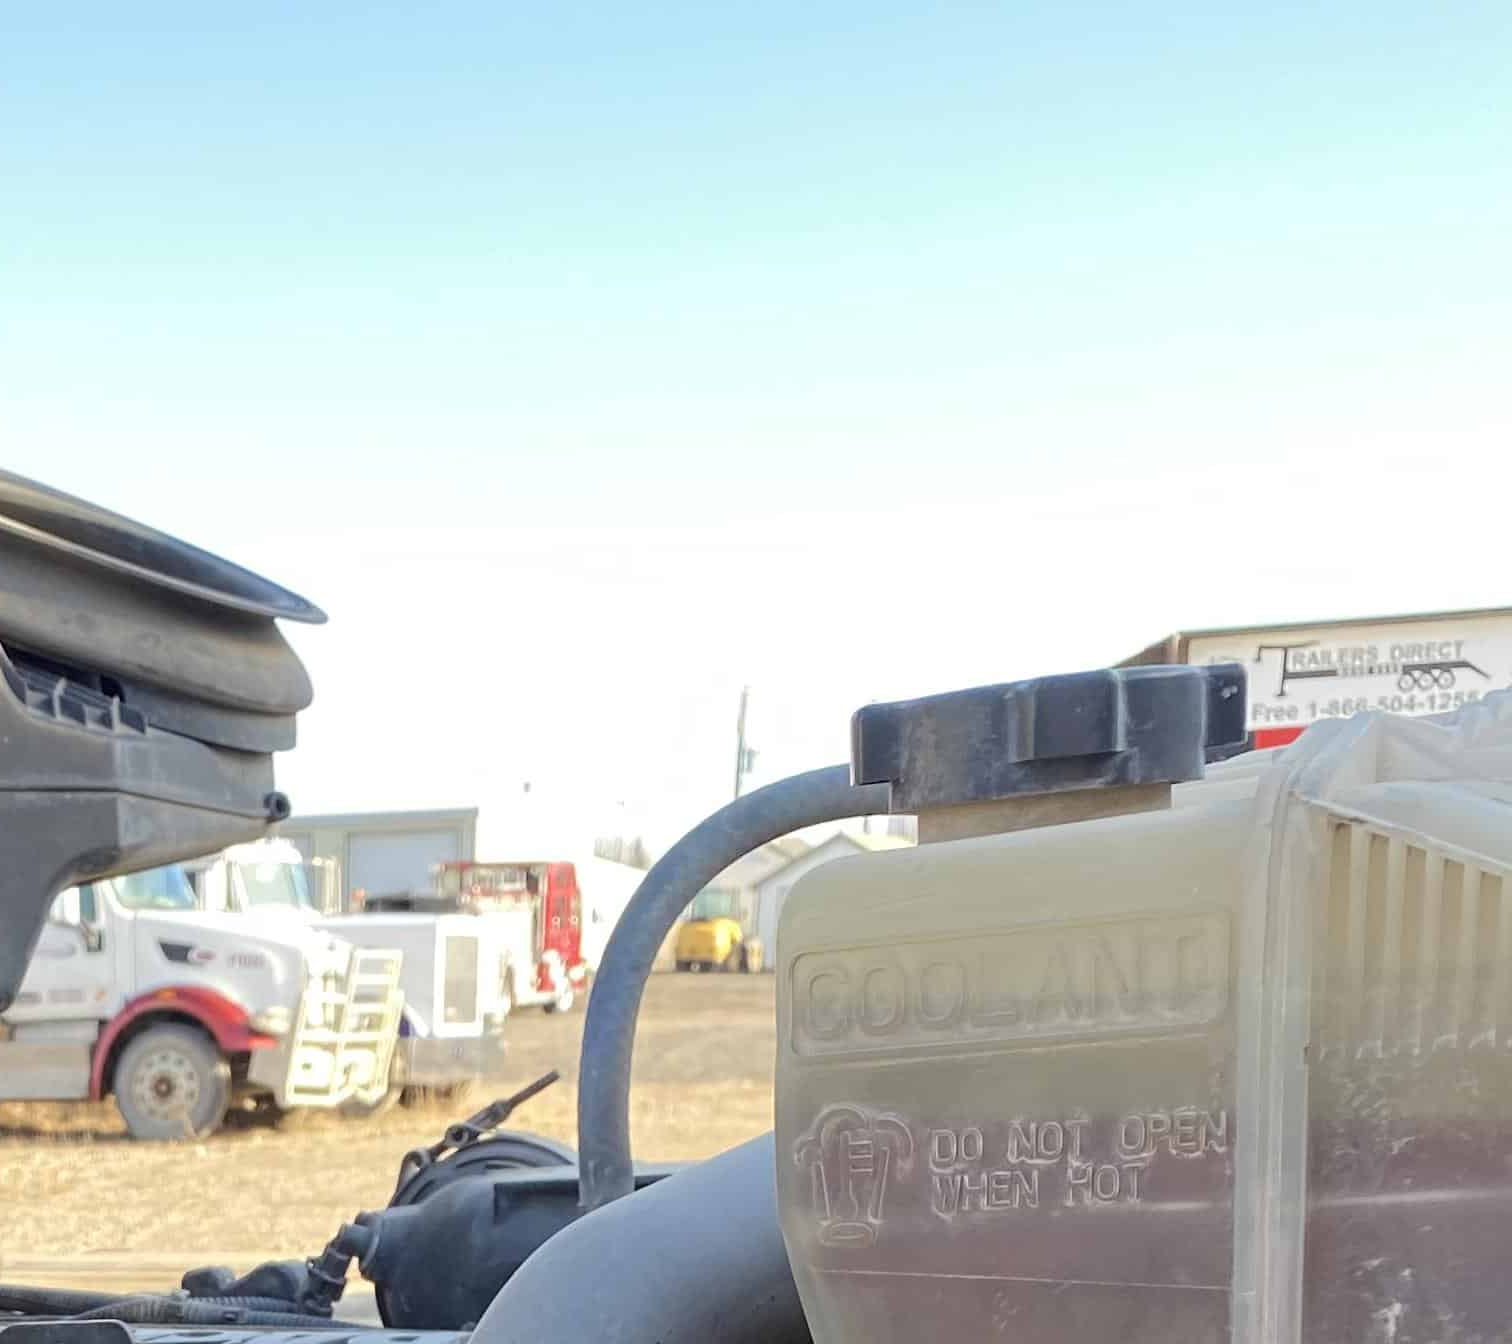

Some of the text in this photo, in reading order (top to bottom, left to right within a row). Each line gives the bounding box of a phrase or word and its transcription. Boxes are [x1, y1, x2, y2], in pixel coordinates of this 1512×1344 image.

[1390, 640, 1465, 661] DIRECT
[1252, 701, 1299, 721] Free
[804, 931, 1220, 1039] COOLANT
[930, 1108, 1228, 1170] DO NOT OPEN
[931, 1161, 1148, 1213] WHEN HOT
